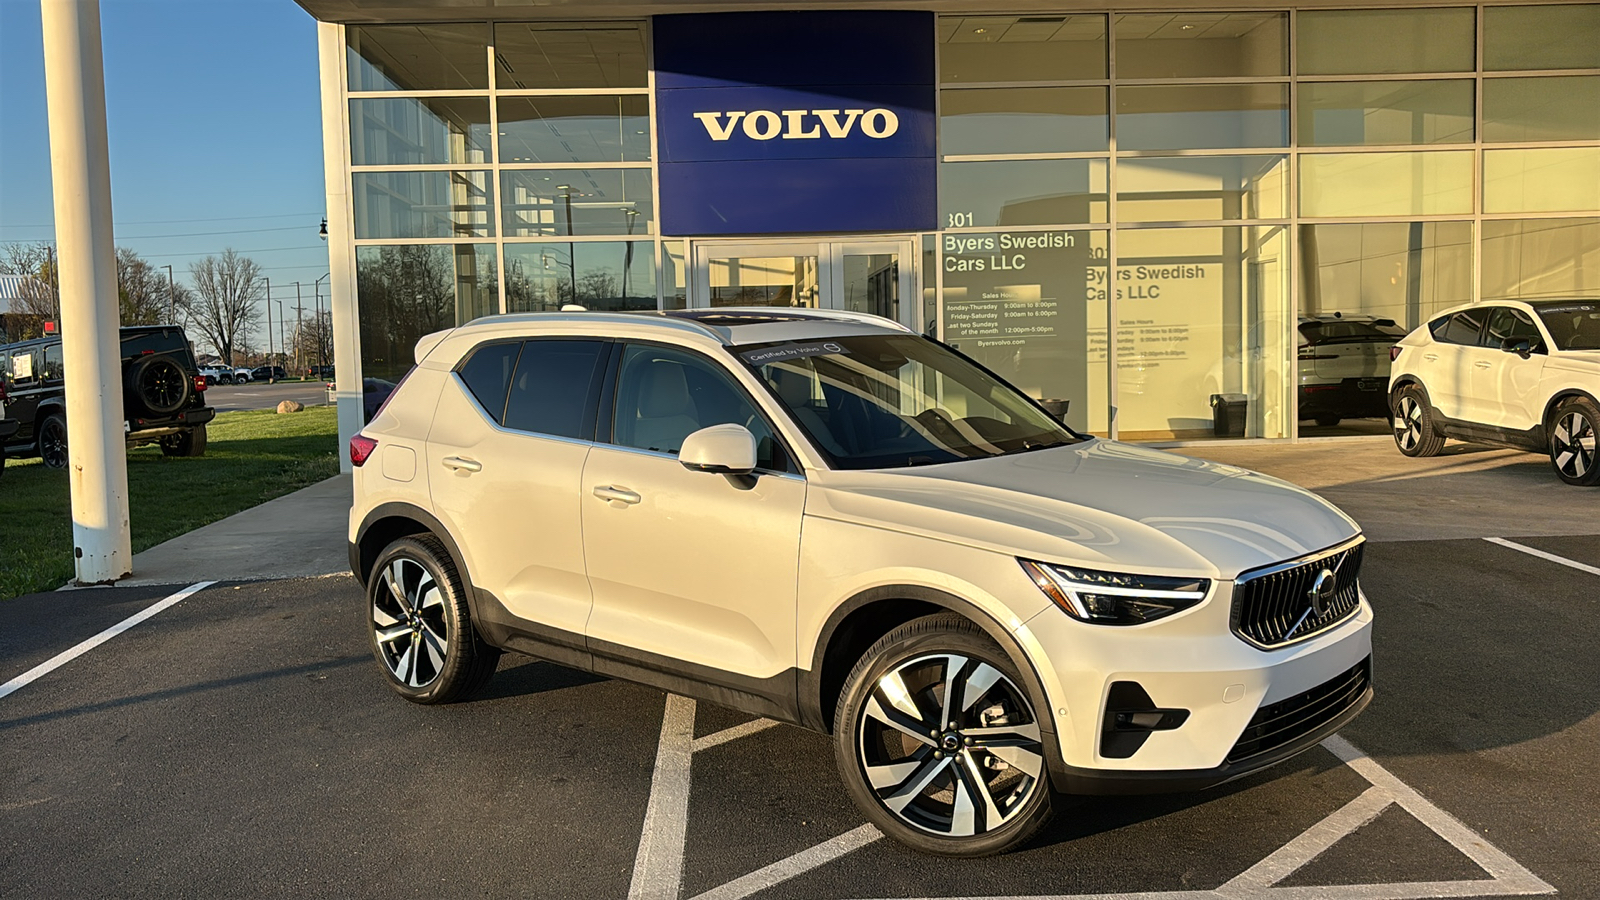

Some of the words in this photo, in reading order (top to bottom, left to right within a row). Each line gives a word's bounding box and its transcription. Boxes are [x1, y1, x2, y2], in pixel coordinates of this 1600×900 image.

[693, 108, 899, 141] VOLVO
[945, 235, 995, 254] Byers
[1000, 232, 1075, 249] Swedish
[945, 256, 985, 272] Cars
[991, 254, 1026, 270] LLC
[1086, 267, 1131, 285] Byrs
[1086, 287, 1123, 300] Cas
[972, 321, 999, 329] Sundays
[977, 339, 1026, 347] Byersvolvo.com
[750, 350, 787, 361] Certified
